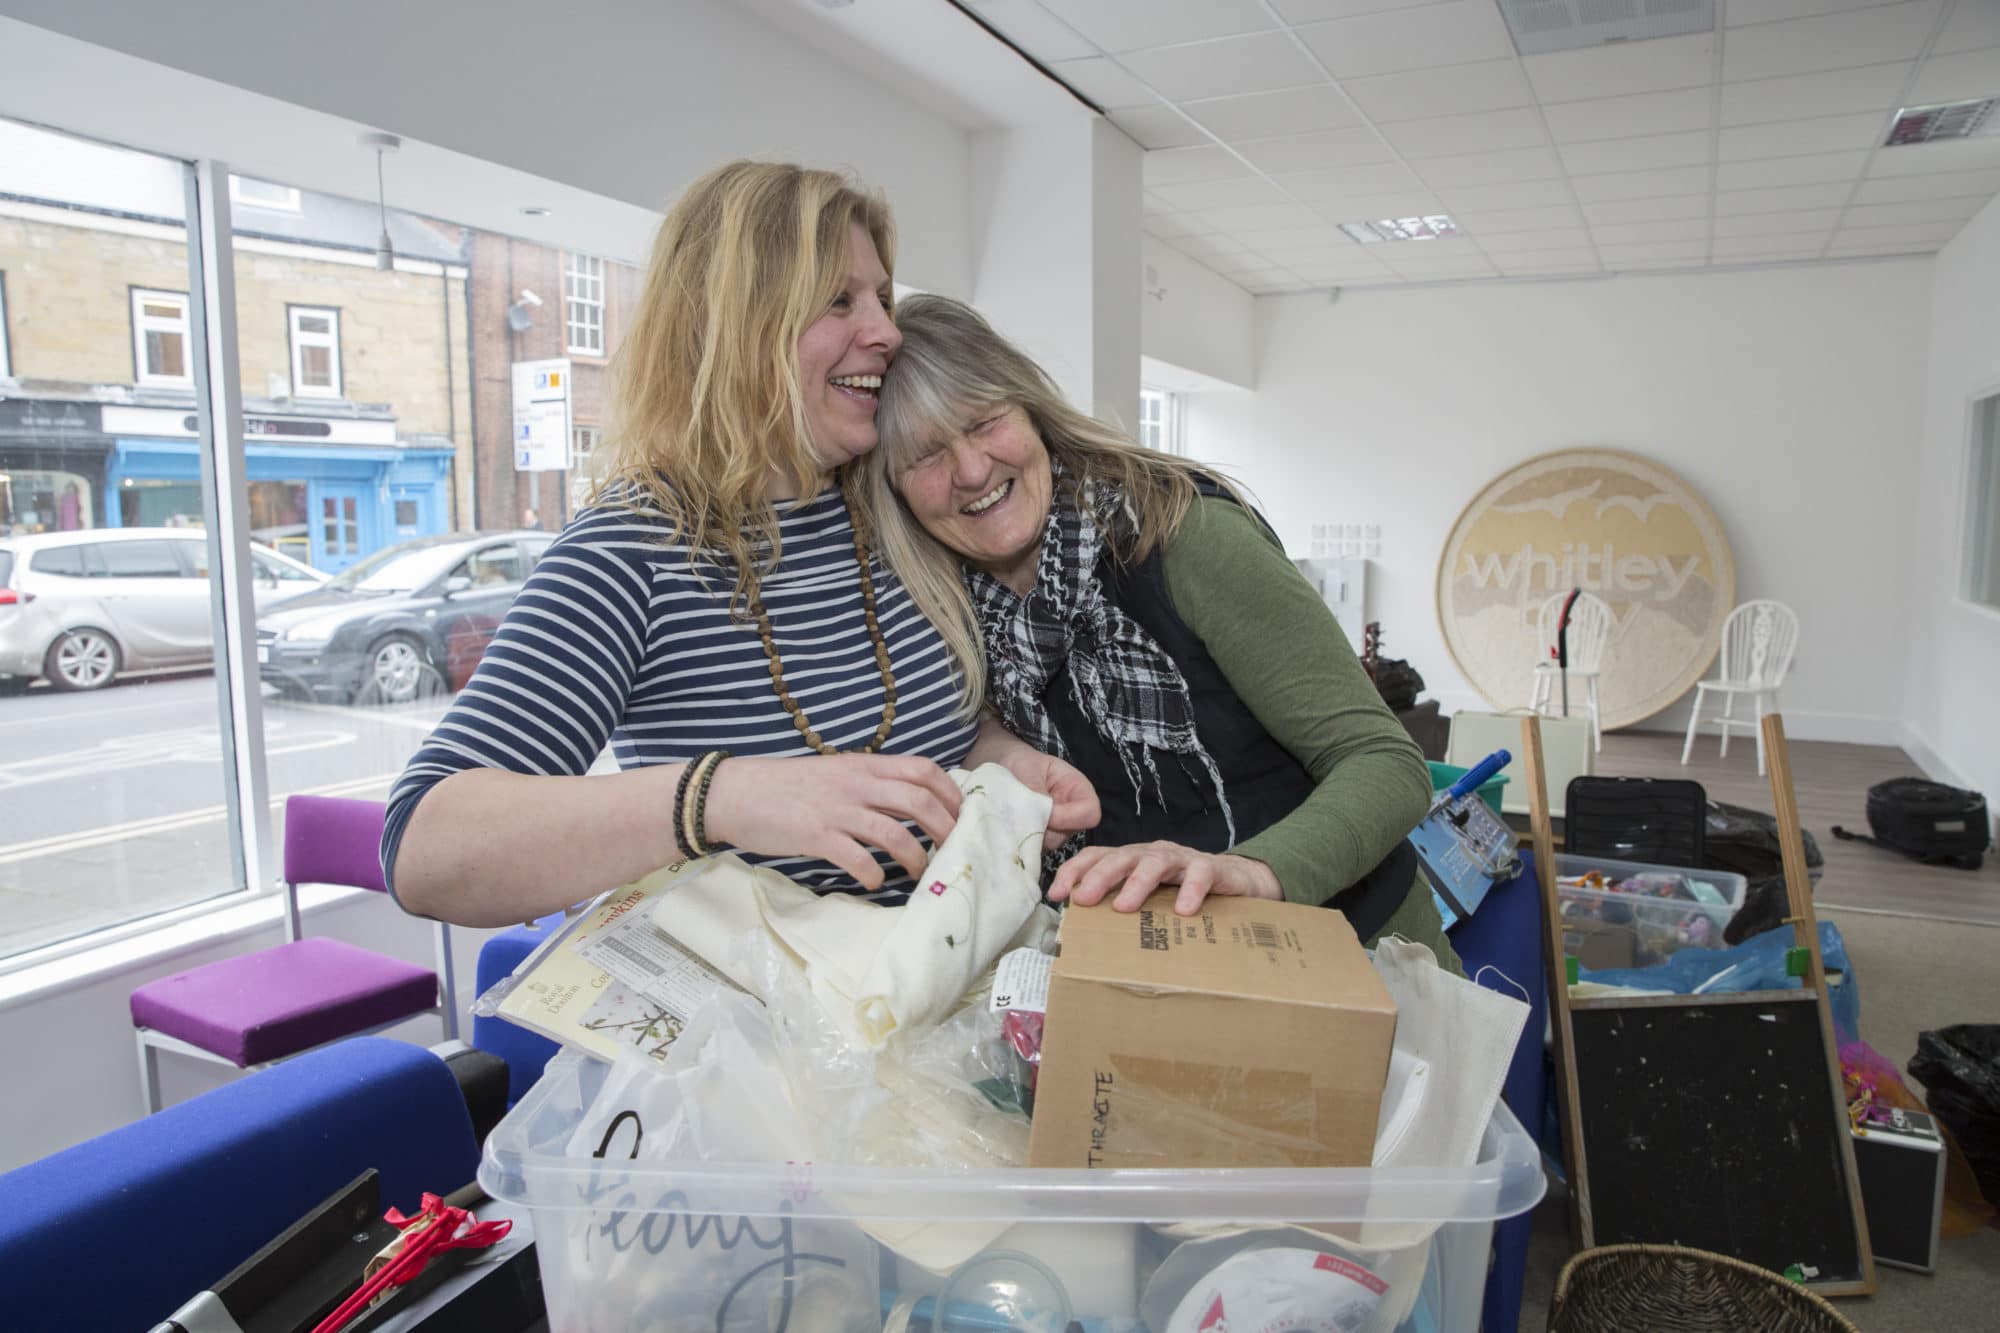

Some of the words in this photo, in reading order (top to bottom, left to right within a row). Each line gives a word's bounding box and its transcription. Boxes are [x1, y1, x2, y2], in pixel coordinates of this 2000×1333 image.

[1466, 543, 1701, 600] whitley
[1155, 927, 1169, 951] CANS
[1088, 1070, 1114, 1169] THRACITE
